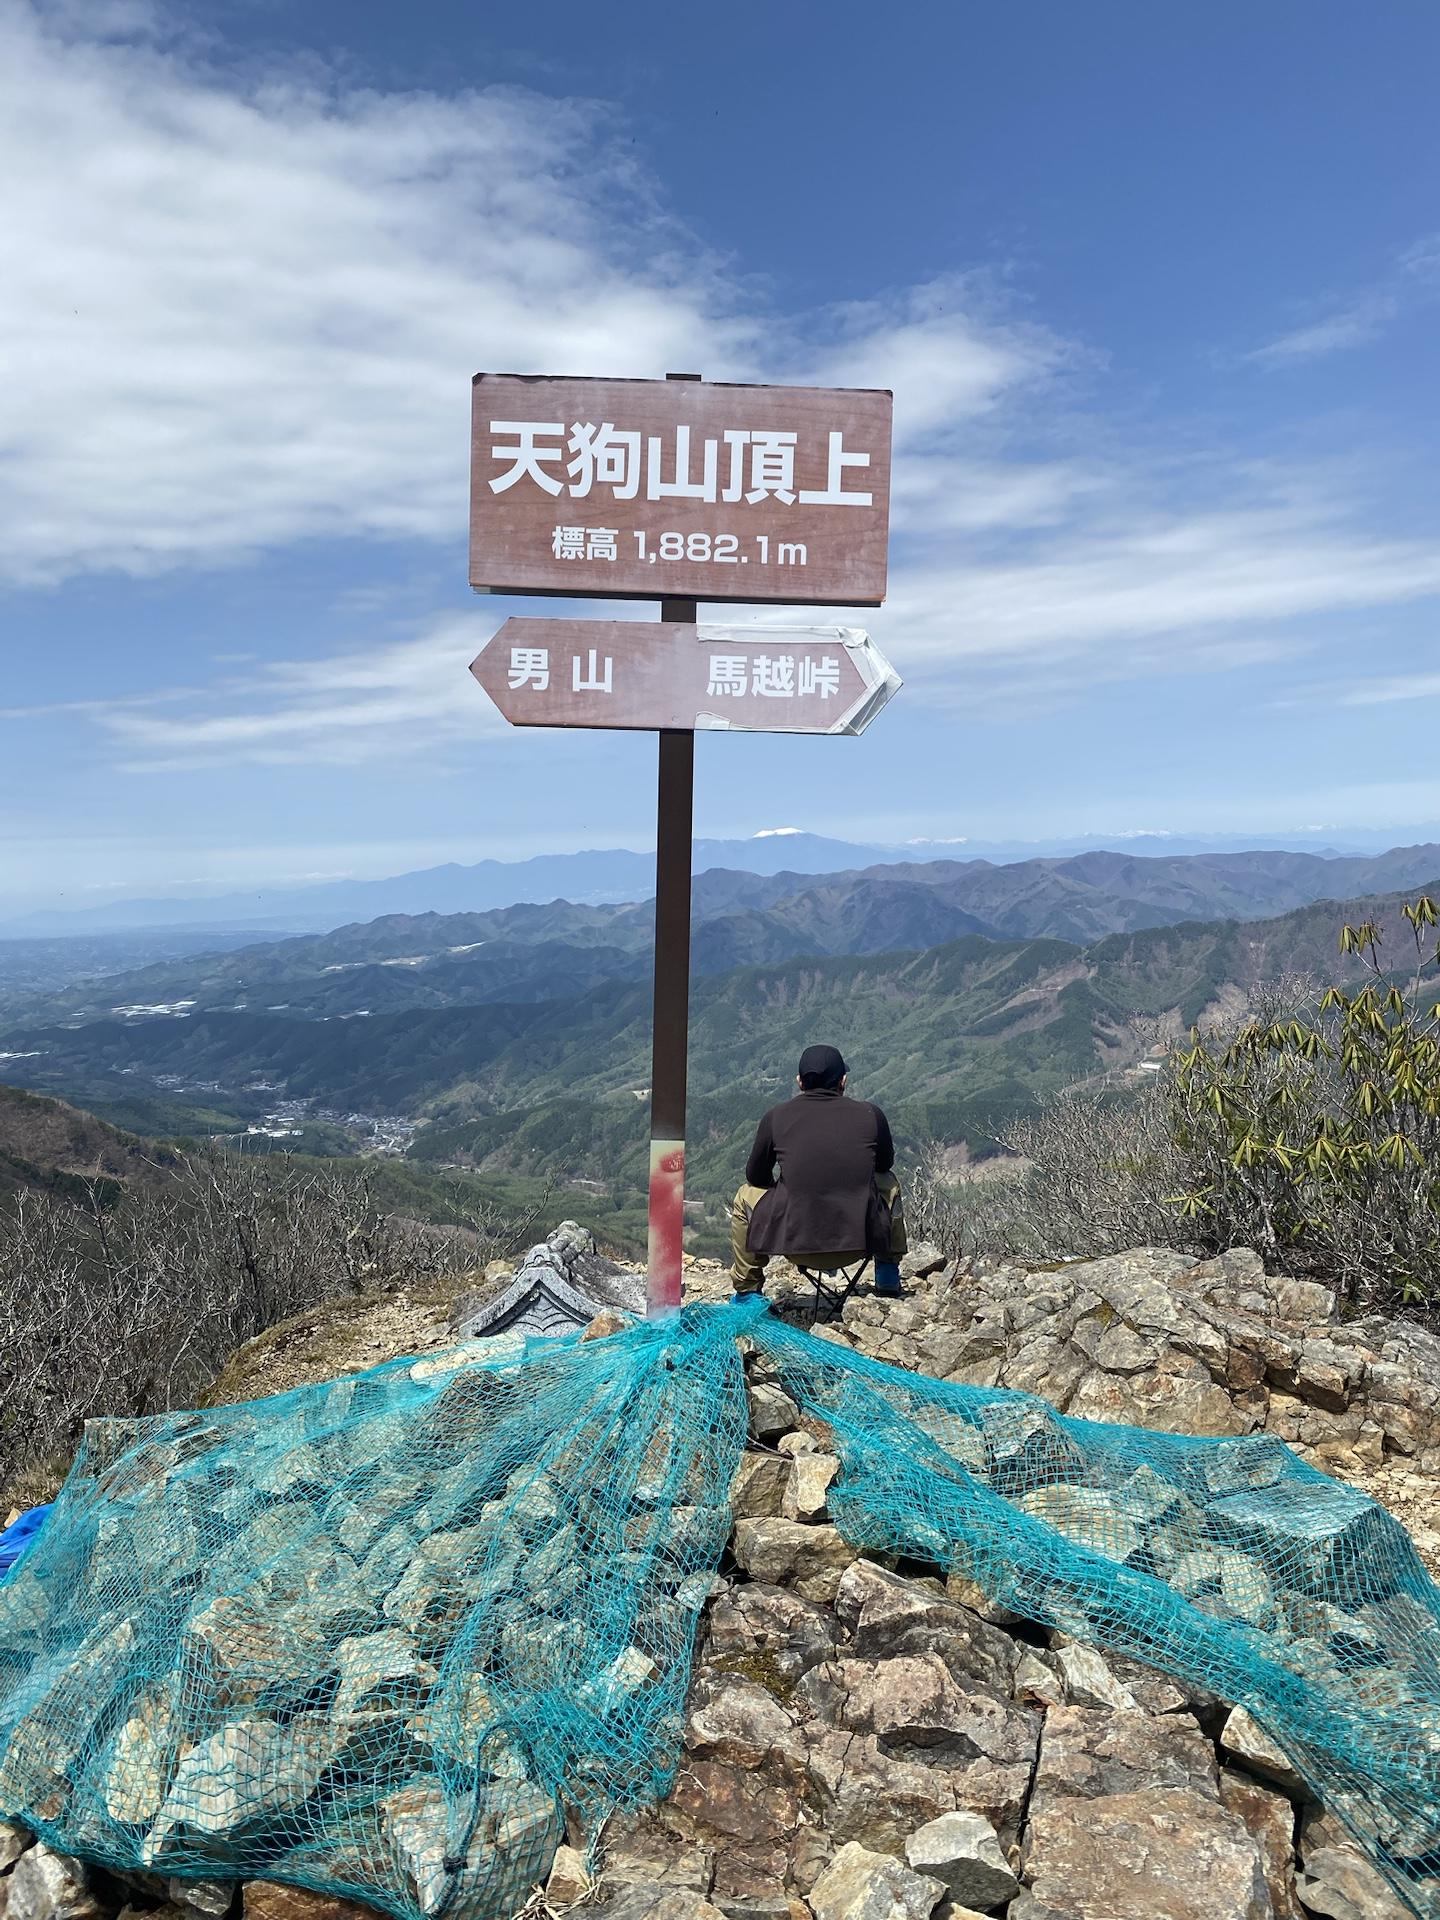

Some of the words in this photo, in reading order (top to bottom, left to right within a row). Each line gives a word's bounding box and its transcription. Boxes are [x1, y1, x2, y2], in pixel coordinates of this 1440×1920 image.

[488, 420, 873, 507] 天狗山頂上
[552, 526, 619, 562] 標高
[633, 530, 807, 566] 1,882.1m
[706, 654, 840, 700] 馬越峠
